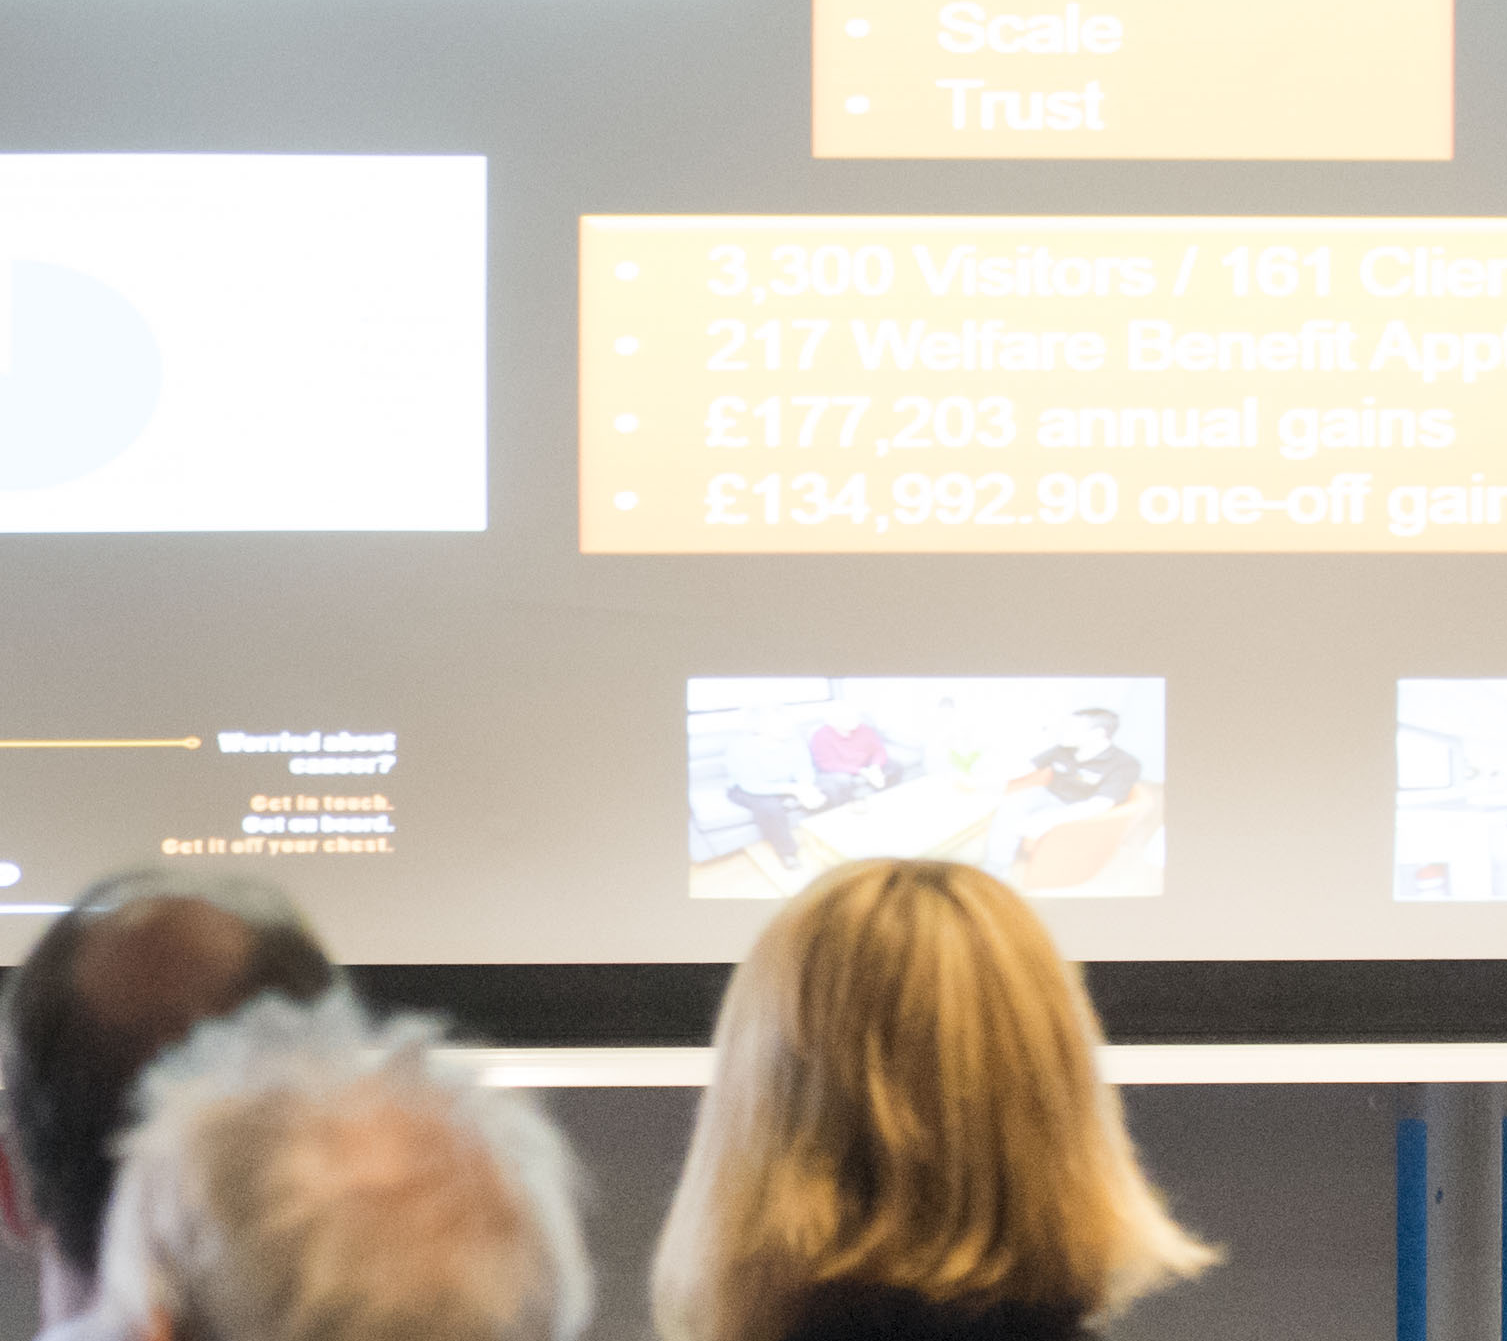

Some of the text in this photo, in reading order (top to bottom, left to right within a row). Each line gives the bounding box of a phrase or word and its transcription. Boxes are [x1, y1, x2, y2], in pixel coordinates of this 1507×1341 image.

[936, 1, 1124, 56] Scale
[935, 78, 1105, 132] Trust
[706, 243, 896, 305] 3,300
[914, 245, 1159, 298] Visitors
[1171, 245, 1196, 298] /
[1223, 247, 1334, 298] 161
[706, 320, 831, 372] 217
[847, 319, 1107, 374] Welfare
[1129, 319, 1355, 373] Benefit
[704, 396, 1456, 461] £177,203 annual gains
[704, 474, 1123, 534] £134,992.90
[1138, 473, 1375, 527] one-off
[217, 729, 397, 753] Worried about
[241, 814, 286, 834] Get
[287, 816, 319, 834] on
[249, 793, 395, 812] Get in touch.
[160, 836, 395, 858] Get it off your chest.
